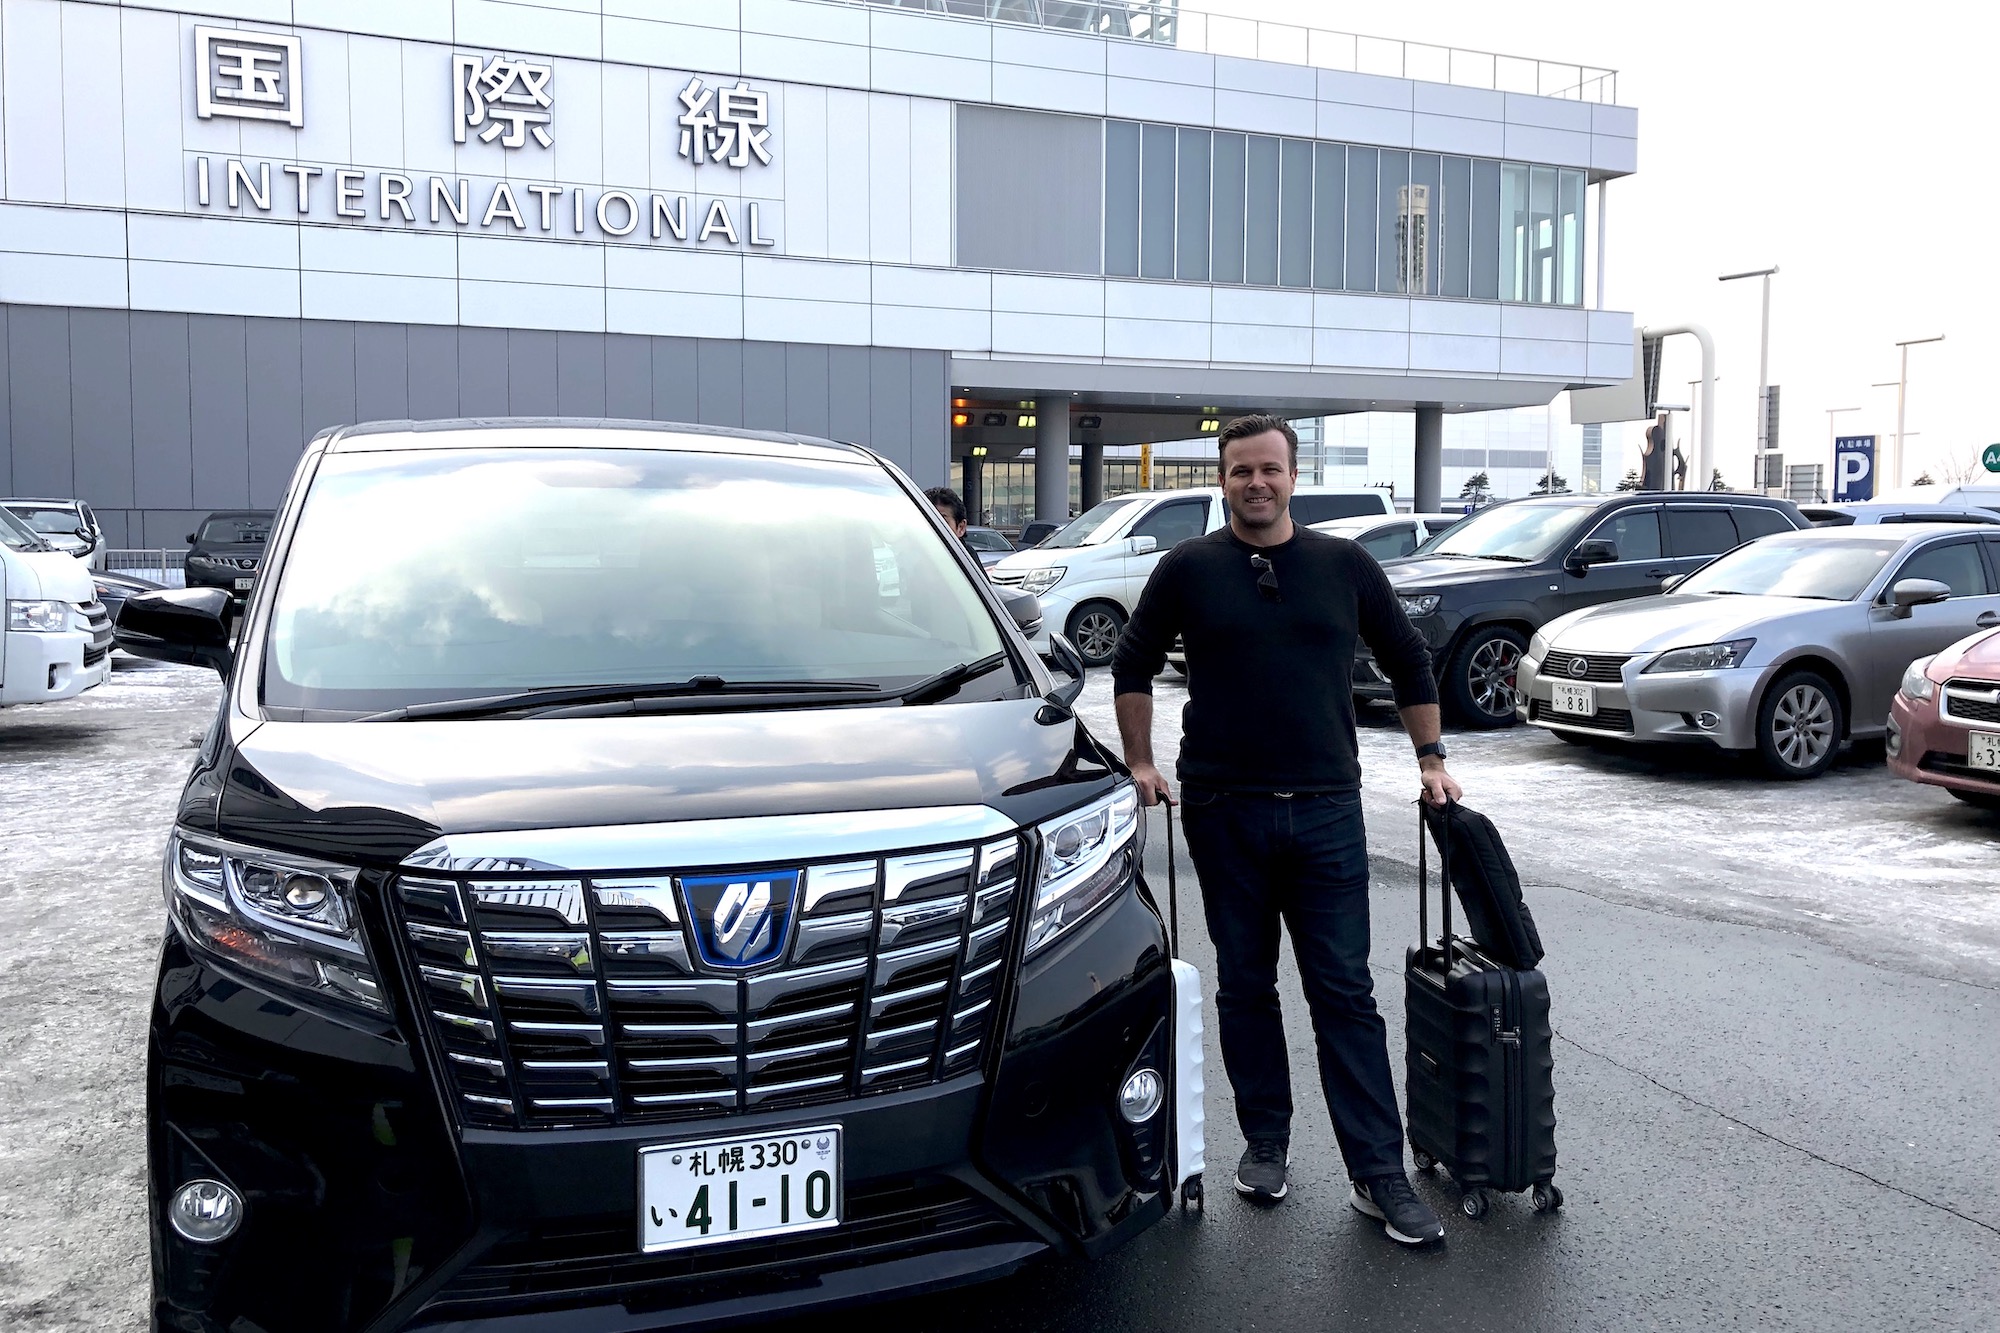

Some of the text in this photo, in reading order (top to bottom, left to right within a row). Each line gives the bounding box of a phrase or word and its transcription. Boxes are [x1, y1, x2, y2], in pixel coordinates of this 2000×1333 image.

[194, 24, 773, 168] 国際線
[197, 156, 775, 247] INTERNATIONAL
[1837, 451, 1870, 494] P
[1986, 748, 2000, 767] 3
[1987, 736, 2000, 747] 札
[689, 1140, 798, 1177] 札幌 330
[651, 1170, 831, 1235] い 41-10
